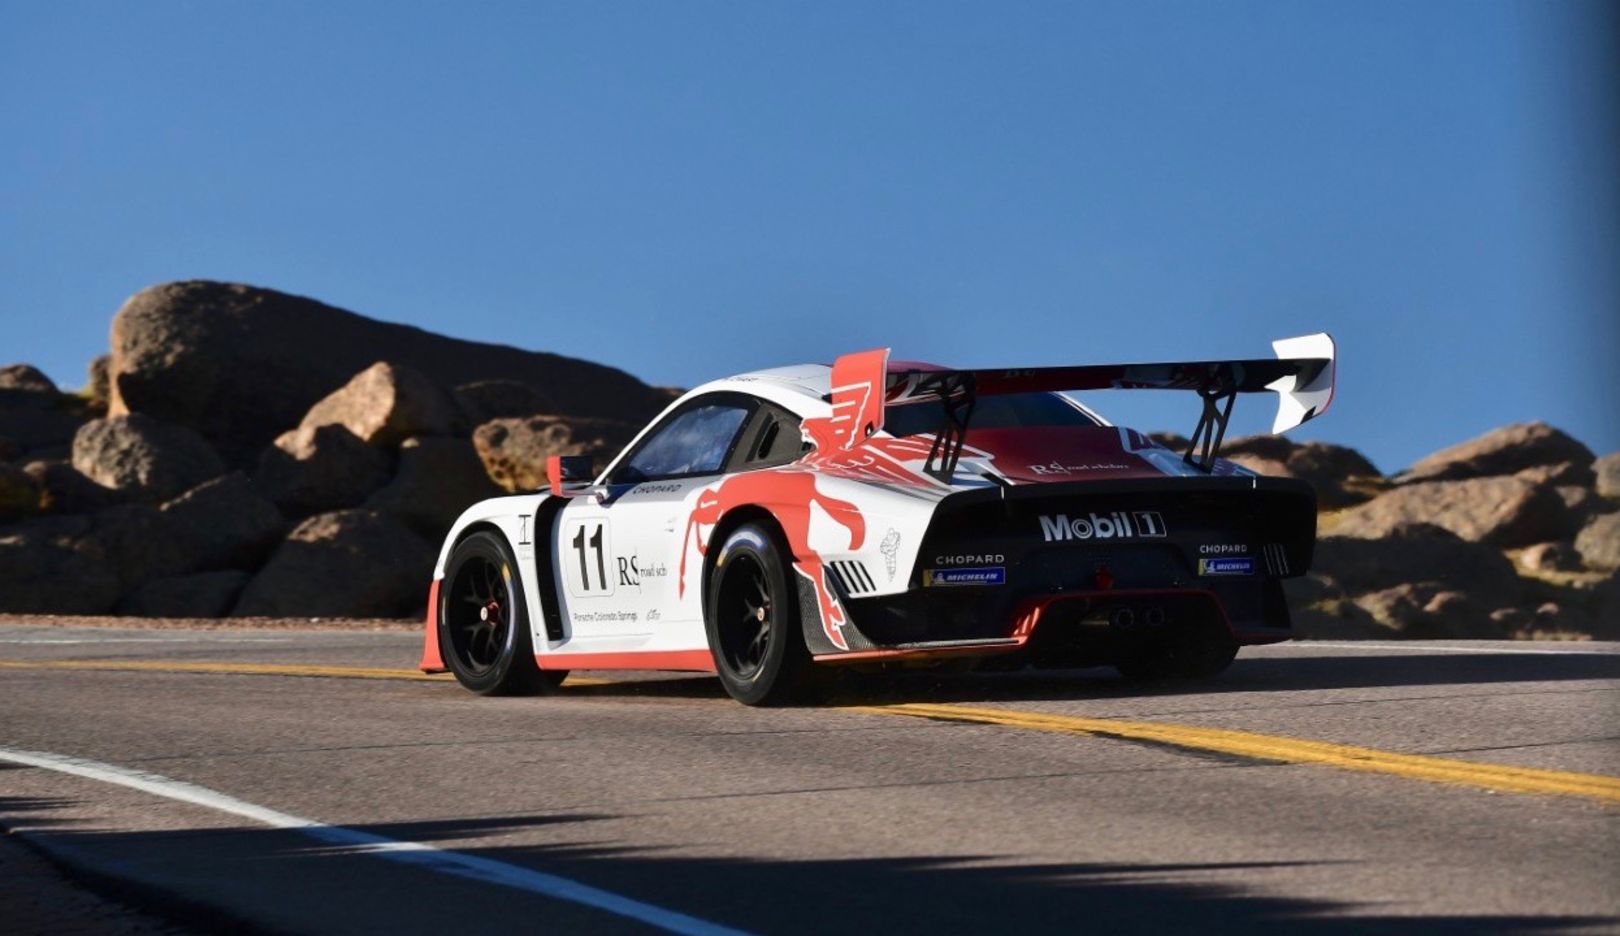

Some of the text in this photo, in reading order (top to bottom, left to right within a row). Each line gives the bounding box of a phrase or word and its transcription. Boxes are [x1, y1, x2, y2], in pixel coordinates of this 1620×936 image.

[1039, 511, 1132, 541] Mobil
[1199, 544, 1248, 554] CHOPARD
[572, 523, 607, 591] 11
[935, 554, 1005, 565] CHOPARD
[946, 573, 998, 581] MICHELIN
